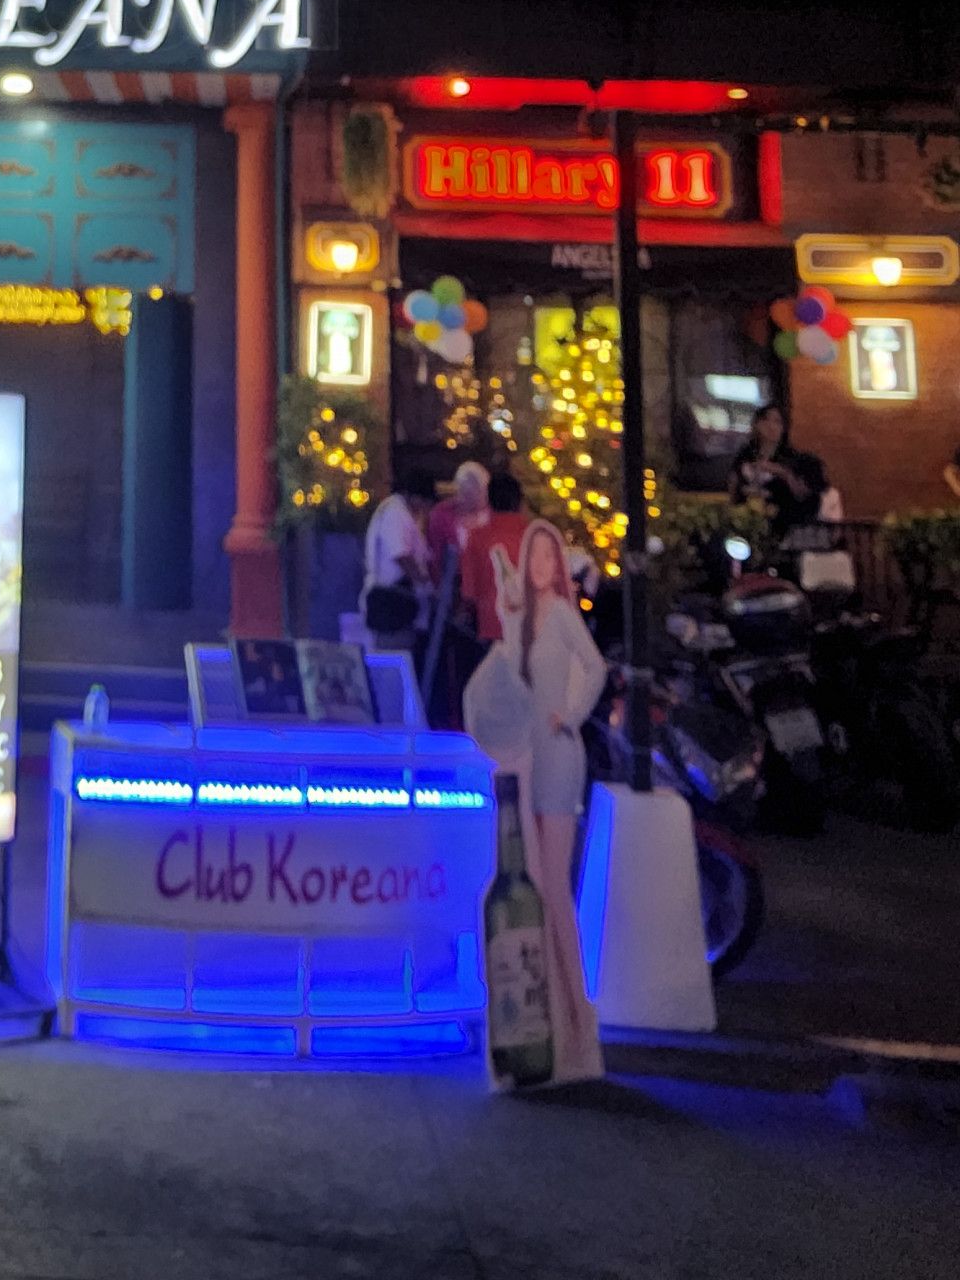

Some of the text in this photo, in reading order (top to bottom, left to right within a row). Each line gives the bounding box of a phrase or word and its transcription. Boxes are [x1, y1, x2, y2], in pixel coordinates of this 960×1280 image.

[424, 146, 620, 209] Hillary
[156, 823, 447, 905] Club Koreana
